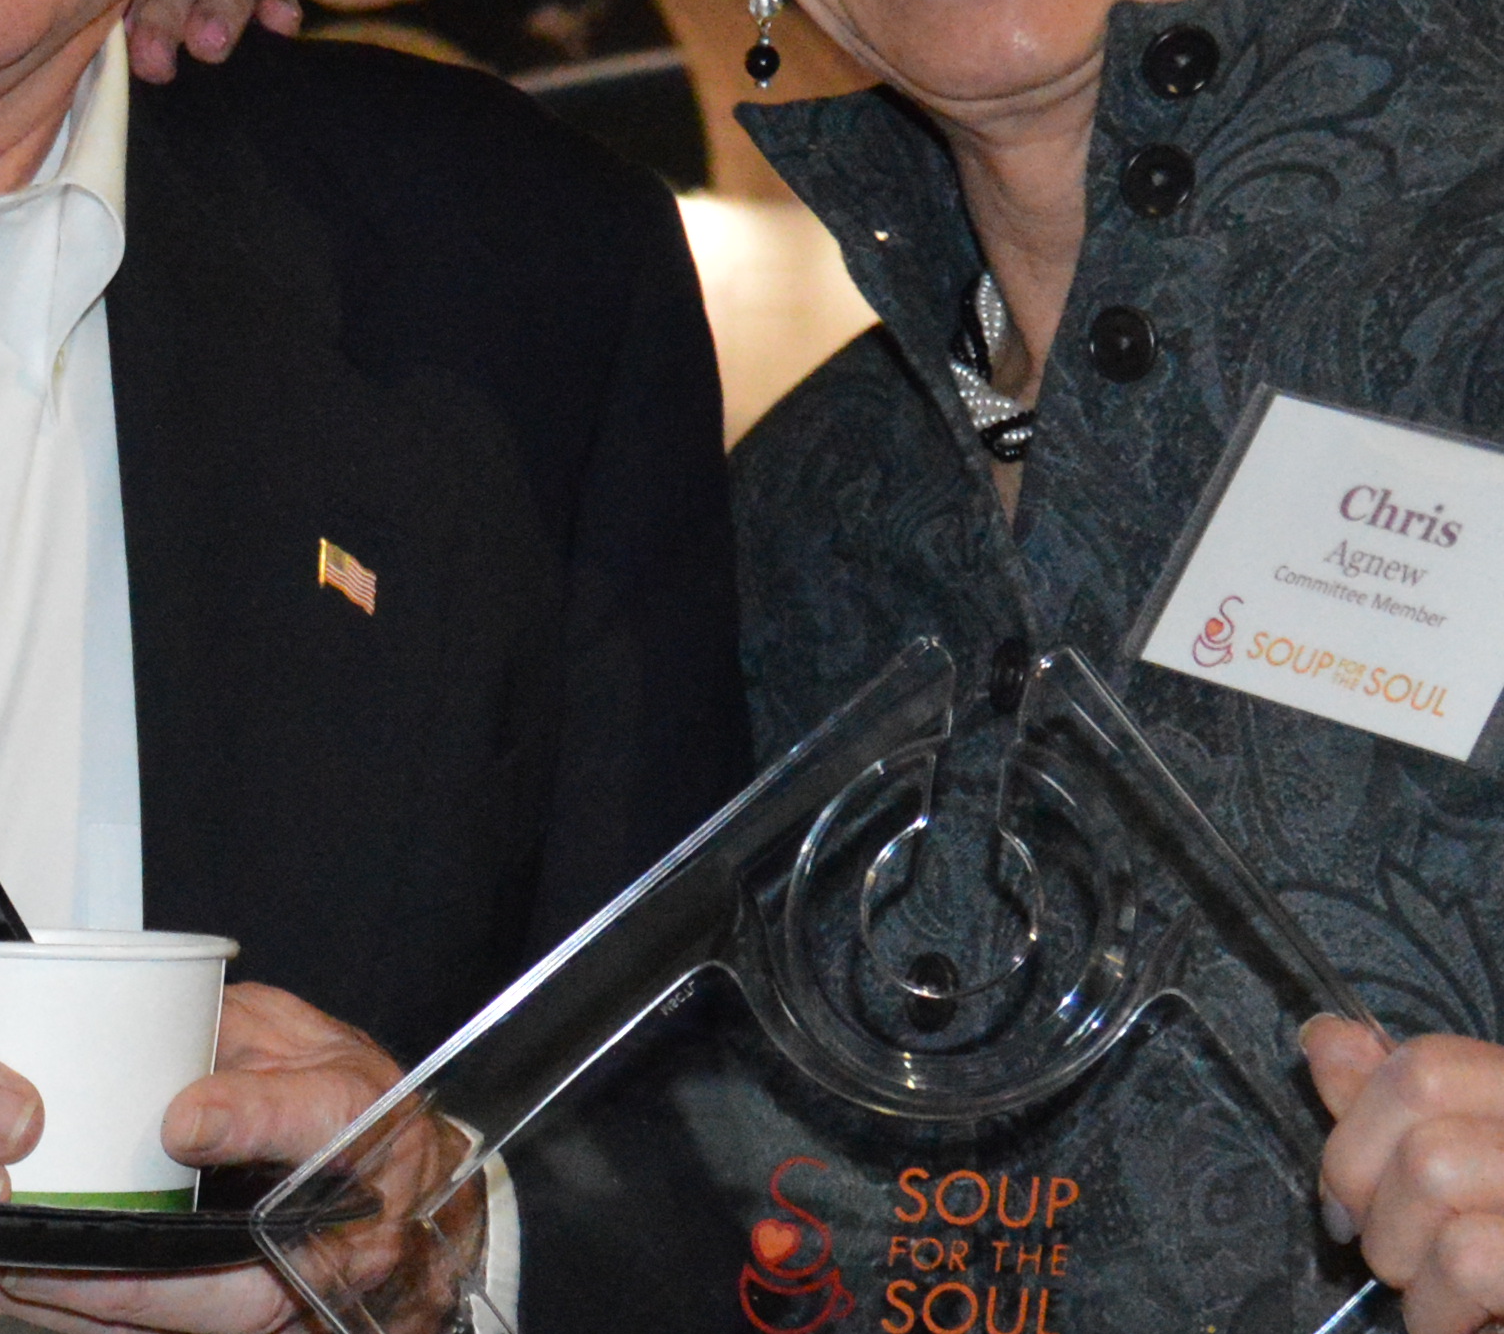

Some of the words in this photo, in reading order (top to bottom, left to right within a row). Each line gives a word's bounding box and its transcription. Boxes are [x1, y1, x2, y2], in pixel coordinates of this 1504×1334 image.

[1338, 483, 1463, 549] Chris
[1322, 538, 1429, 588] Agnew
[1273, 564, 1369, 606] Committee
[1370, 592, 1449, 628] Member
[1246, 630, 1336, 678] SOUP
[1362, 666, 1448, 718] SOUL
[893, 1166, 1081, 1229] SOUP
[887, 1235, 970, 1272] FOR
[992, 1239, 1071, 1277] THE
